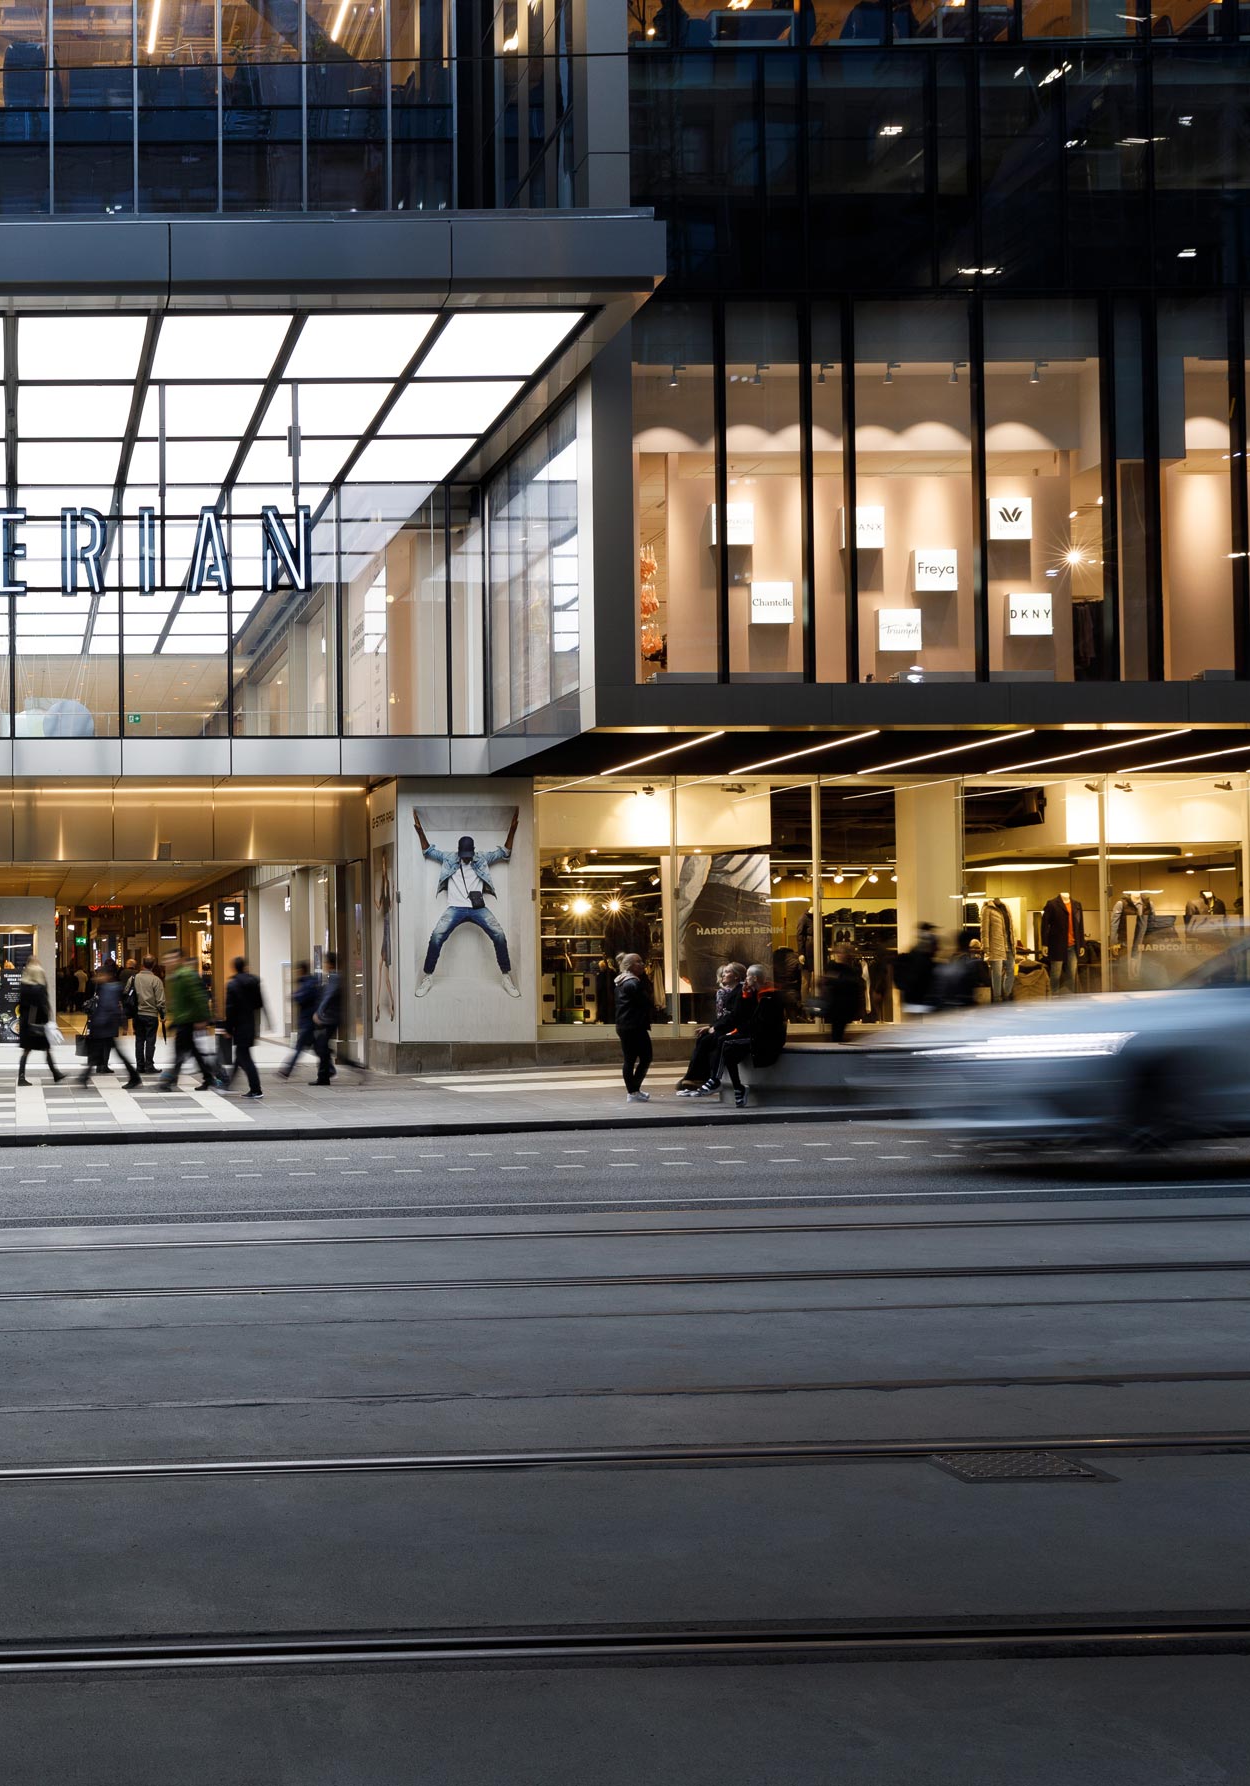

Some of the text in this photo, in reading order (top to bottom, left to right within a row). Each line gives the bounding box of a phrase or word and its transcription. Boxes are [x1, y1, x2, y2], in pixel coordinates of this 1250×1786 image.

[858, 523, 882, 531] ANX
[918, 562, 955, 577] Freya
[752, 598, 793, 607] Chantelle
[1010, 609, 1051, 619] DKNY
[882, 621, 919, 638] Triumph
[696, 926, 784, 935] HARDCORE DENIM
